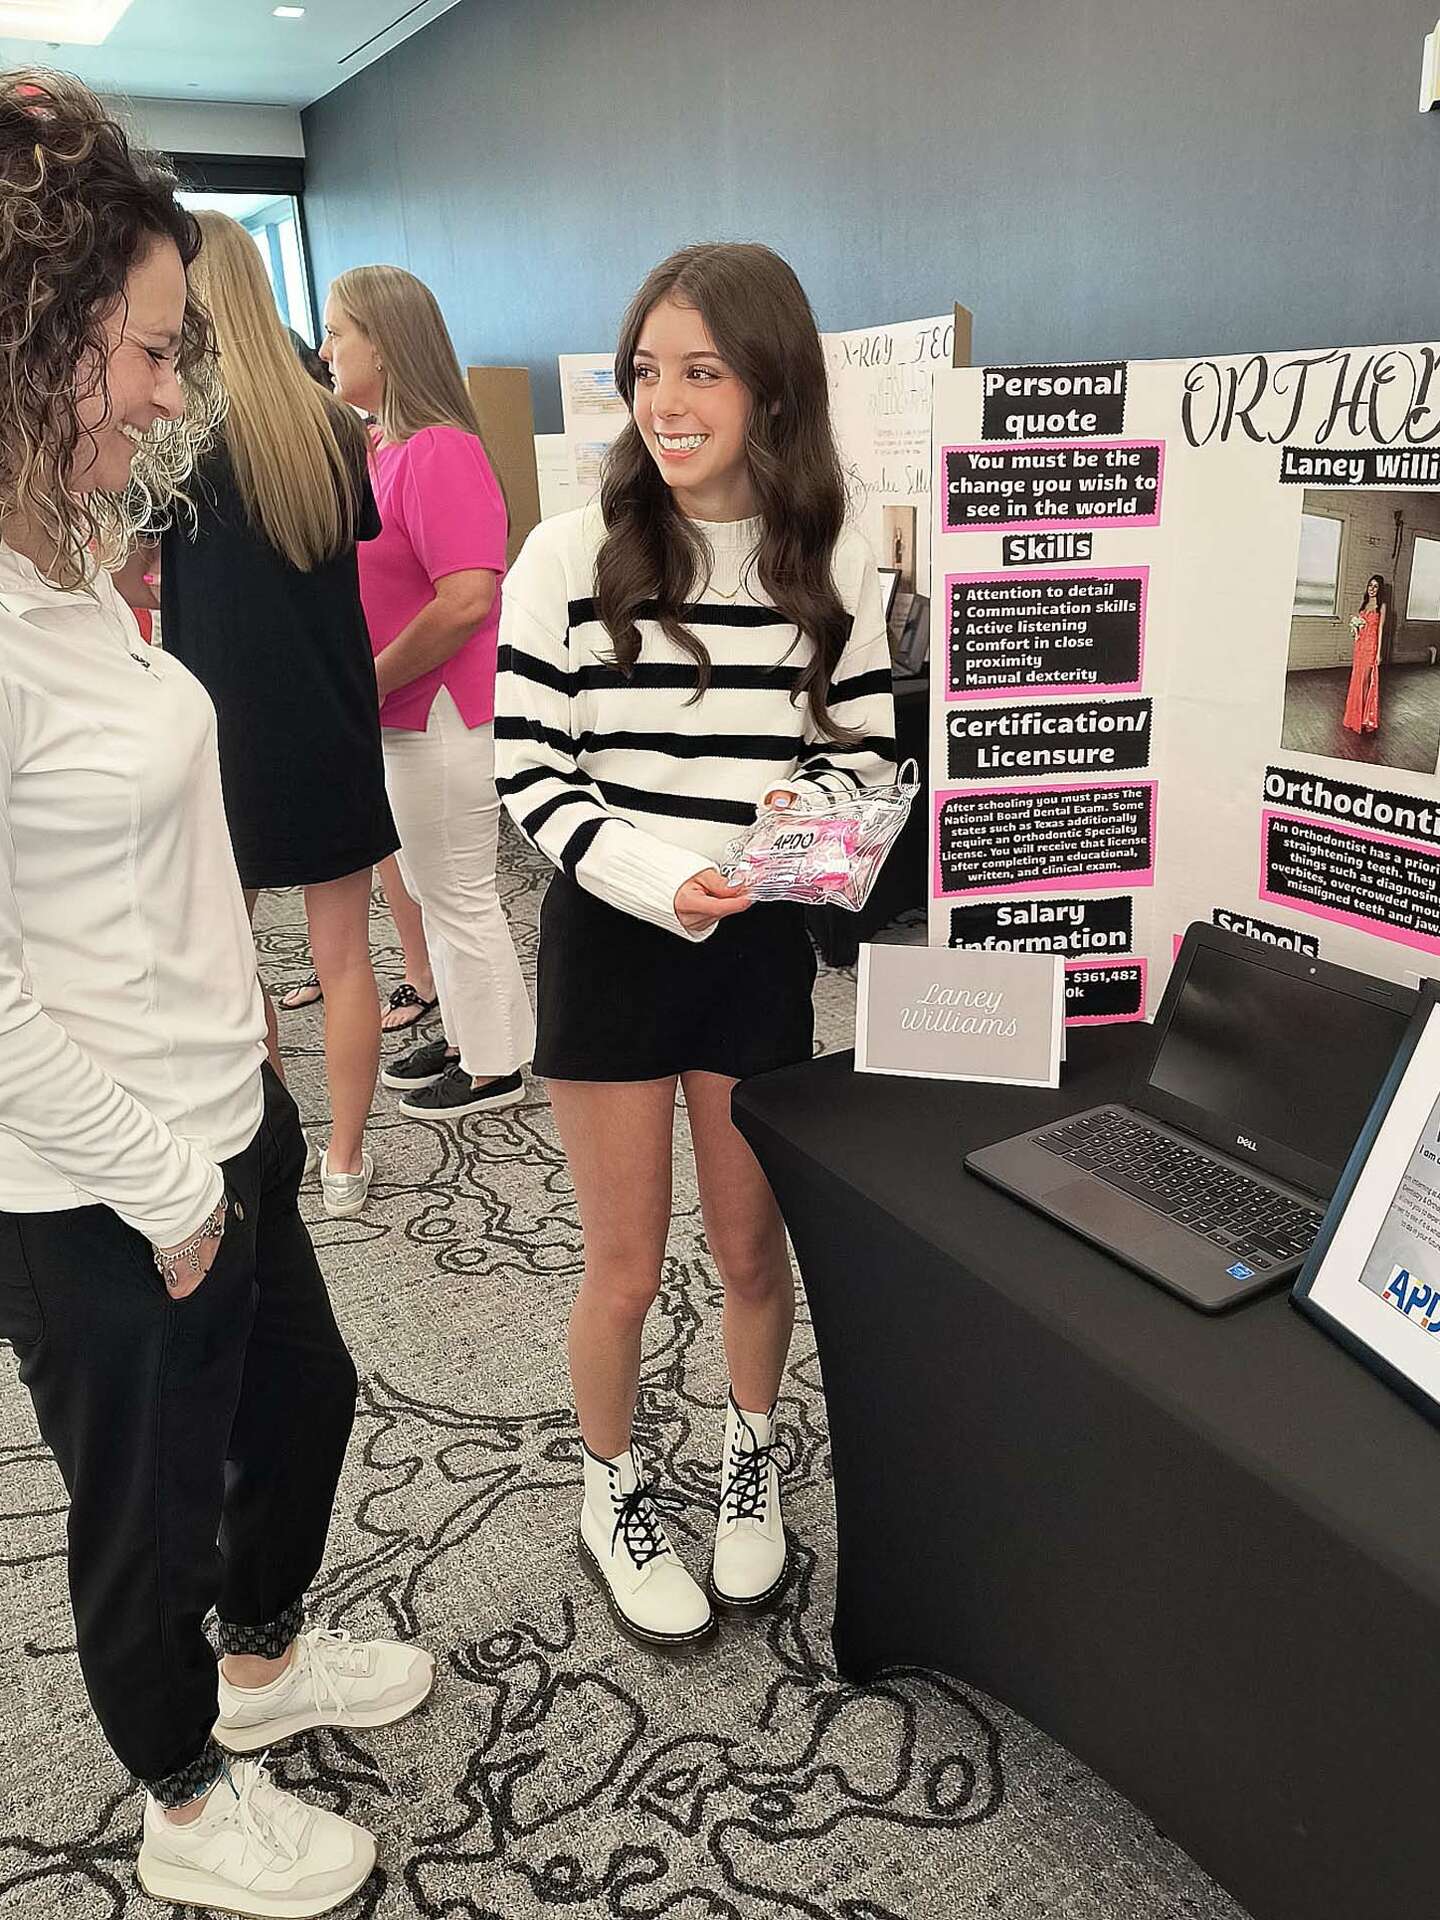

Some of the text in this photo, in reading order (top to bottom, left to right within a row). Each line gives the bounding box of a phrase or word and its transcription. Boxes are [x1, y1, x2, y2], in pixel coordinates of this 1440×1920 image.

[985, 370, 1122, 397] Personal
[1005, 409, 1097, 439] quote
[968, 450, 1140, 470] You must be the
[1285, 452, 1440, 483] Laney Willi
[949, 473, 1157, 497] change you wish to
[966, 498, 1137, 517] see in the world
[1009, 536, 1090, 561] Skills
[966, 583, 1114, 601] Attention to detail
[966, 600, 1137, 618] Communication skills
[966, 619, 1087, 635] Active listening
[966, 635, 1094, 652] Comfort in close
[966, 654, 1042, 671] proximity
[966, 668, 1097, 685] Manual dexterity
[950, 711, 1148, 738] Certification/
[977, 745, 1115, 768] Licensure
[946, 789, 1142, 813] After schooling you must pass The
[1265, 774, 1440, 837] Orthodonti
[945, 802, 1144, 826] National Board Dental Exam. Some
[951, 826, 987, 836] states
[989, 823, 1016, 833] such
[1034, 820, 1065, 829] Texas
[1067, 813, 1137, 826] additionally
[942, 836, 1147, 861] License. You will receive that license
[951, 825, 1137, 849] require an Orthodontic Specialty
[1272, 822, 1440, 875] An Orthodontist has a priori
[950, 847, 1138, 872] after completing an educational,
[1017, 866, 1039, 877] and
[1042, 863, 1083, 875] clinical
[1086, 862, 1121, 871] exam.
[1283, 839, 1436, 890] straightening teeth. They
[1271, 862, 1440, 919] overbites, overcrowded mou
[1290, 852, 1440, 907] things such as diagnosin
[996, 904, 1085, 926] Salary
[1287, 880, 1440, 934] misaligned teeth and jaw
[1073, 970, 1138, 984] $361,482
[916, 983, 1004, 1015] Laney
[900, 1007, 1017, 1037] Williams
[1236, 1135, 1258, 1152] DELL
